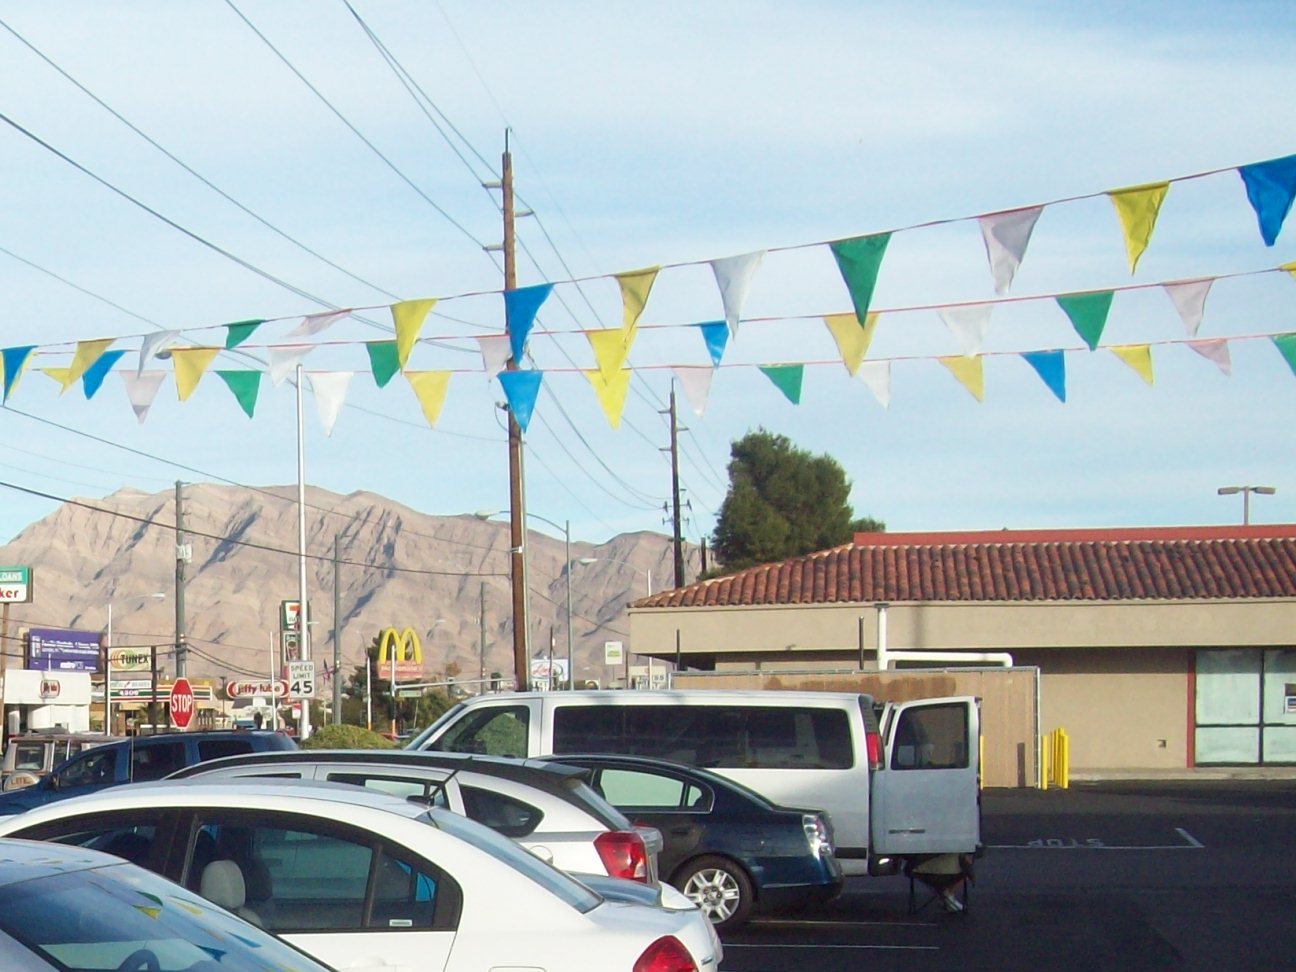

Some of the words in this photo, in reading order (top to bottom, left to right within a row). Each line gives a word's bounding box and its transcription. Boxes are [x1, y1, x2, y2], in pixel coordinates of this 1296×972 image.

[120, 654, 149, 664] TUNEX
[290, 680, 313, 694] 45
[171, 693, 192, 712] STOP
